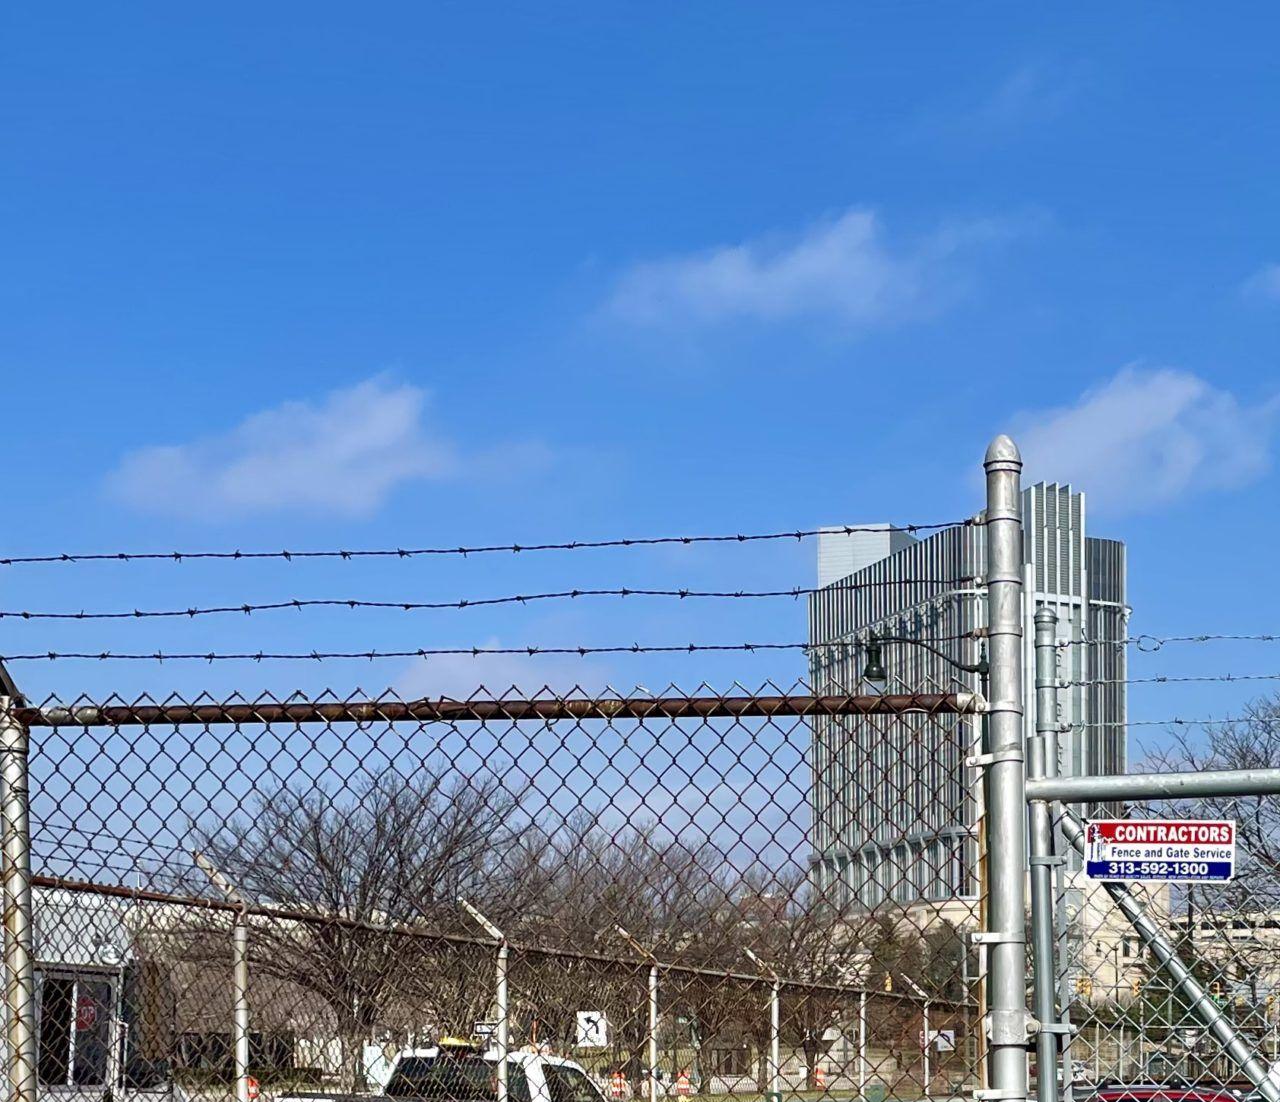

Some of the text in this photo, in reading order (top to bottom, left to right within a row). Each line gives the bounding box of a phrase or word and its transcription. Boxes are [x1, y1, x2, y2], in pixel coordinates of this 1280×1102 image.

[1115, 825, 1230, 842] CONTRACTORS
[1111, 846, 1232, 859] Fence and Gate Service
[1108, 862, 1209, 875] 313-592-1300
